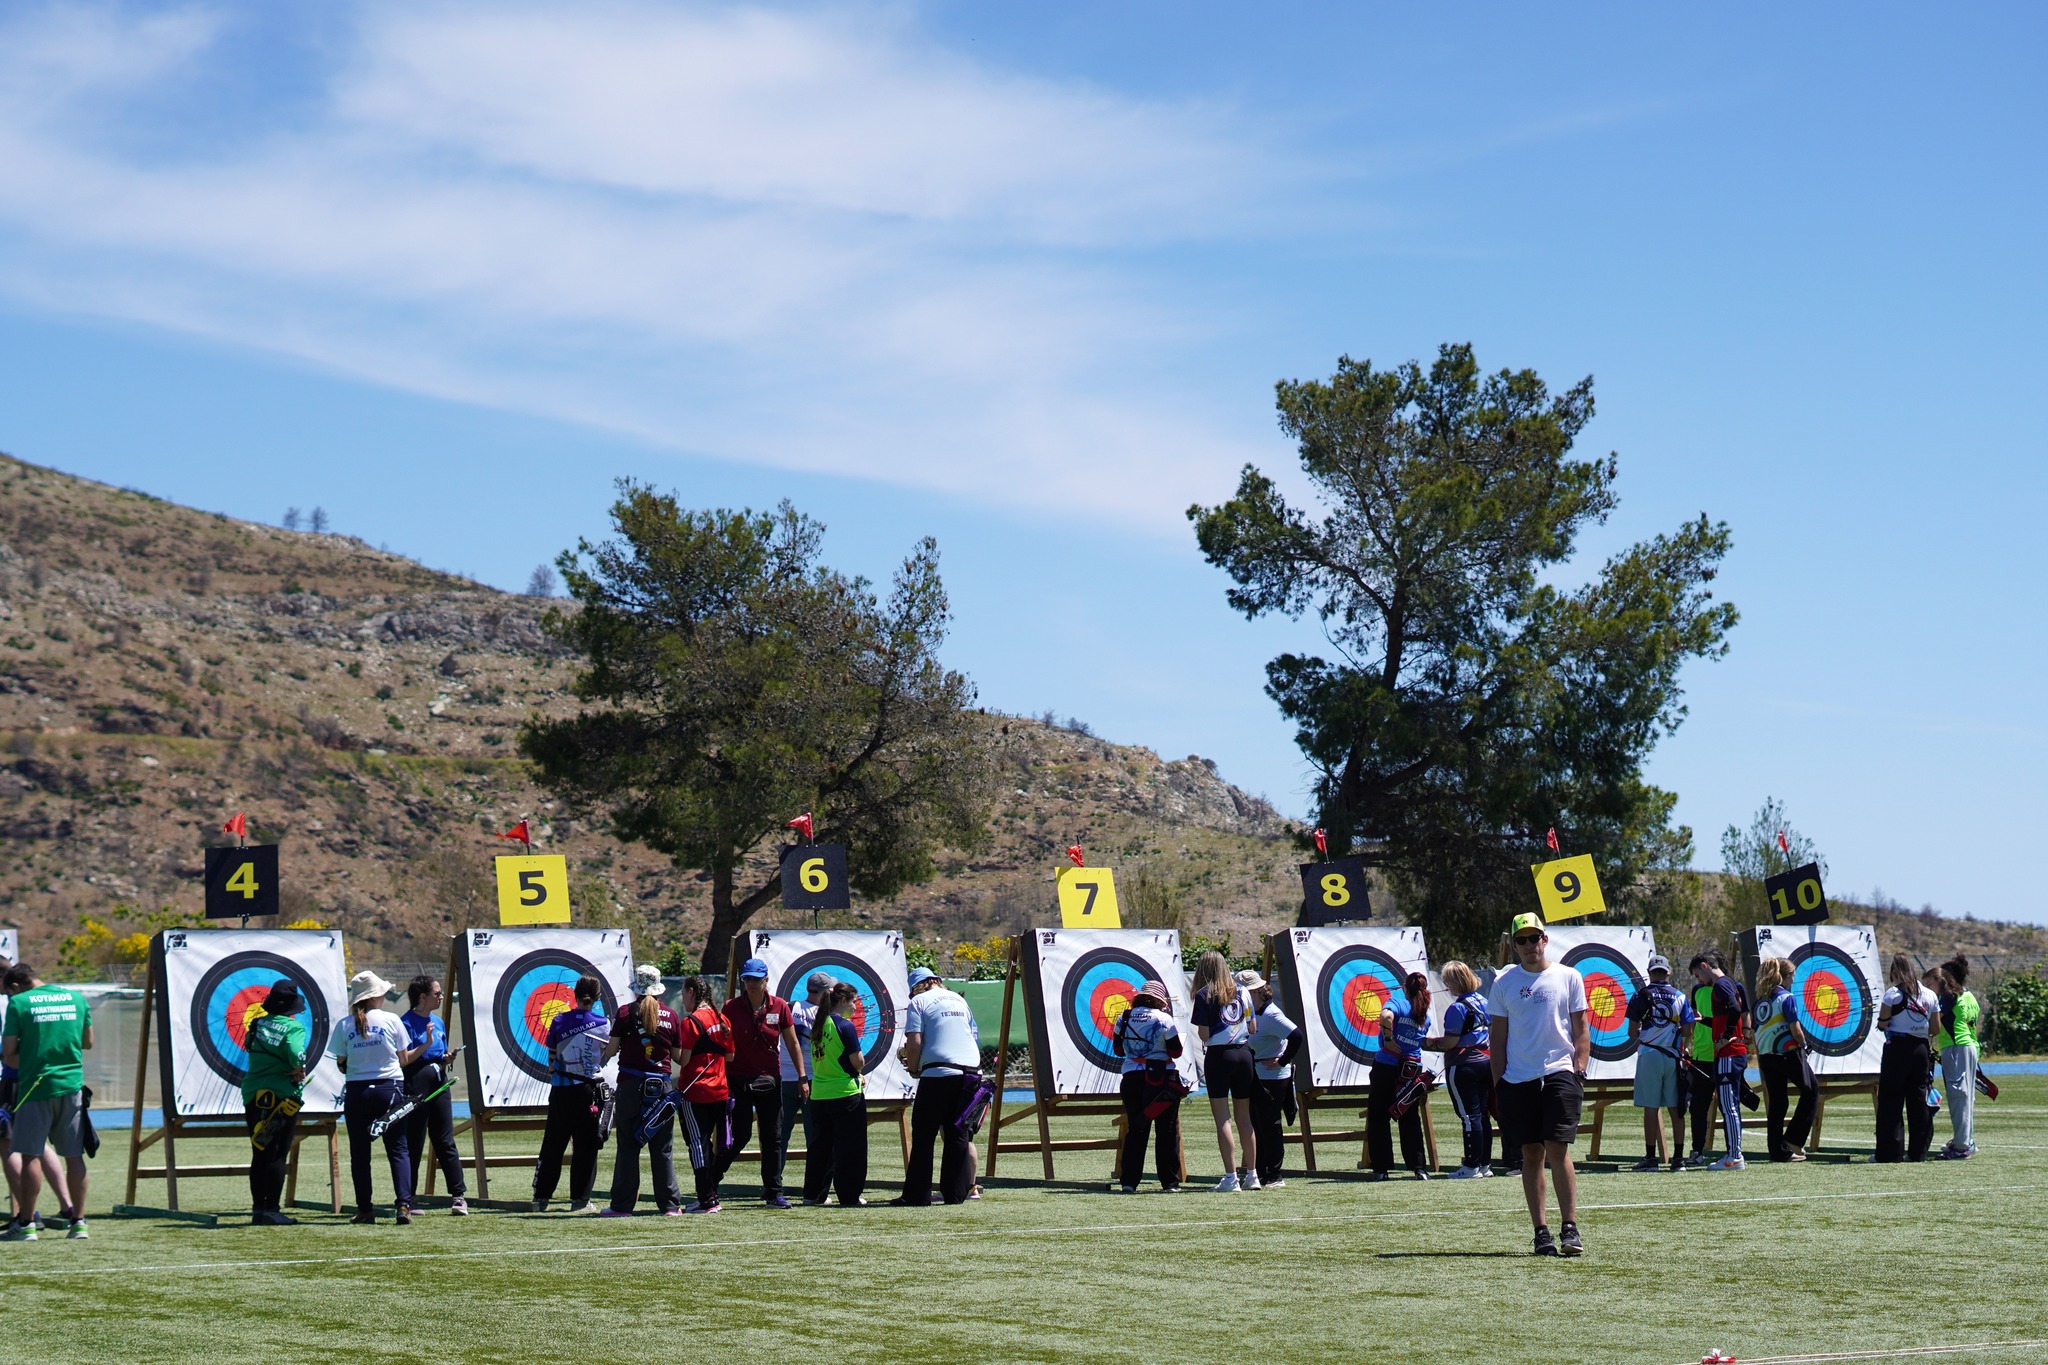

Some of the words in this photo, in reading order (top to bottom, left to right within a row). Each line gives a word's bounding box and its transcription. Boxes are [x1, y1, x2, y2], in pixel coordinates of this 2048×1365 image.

[225, 862, 259, 899] 4
[518, 870, 548, 907] 5
[799, 857, 829, 893] 6
[1320, 873, 1350, 907] 8
[1553, 870, 1582, 904] 9
[1075, 882, 1099, 915] 7
[1771, 878, 1822, 920] 10
[29, 992, 73, 1004] KOTAKOS
[352, 1039, 383, 1049] ARCHERY
